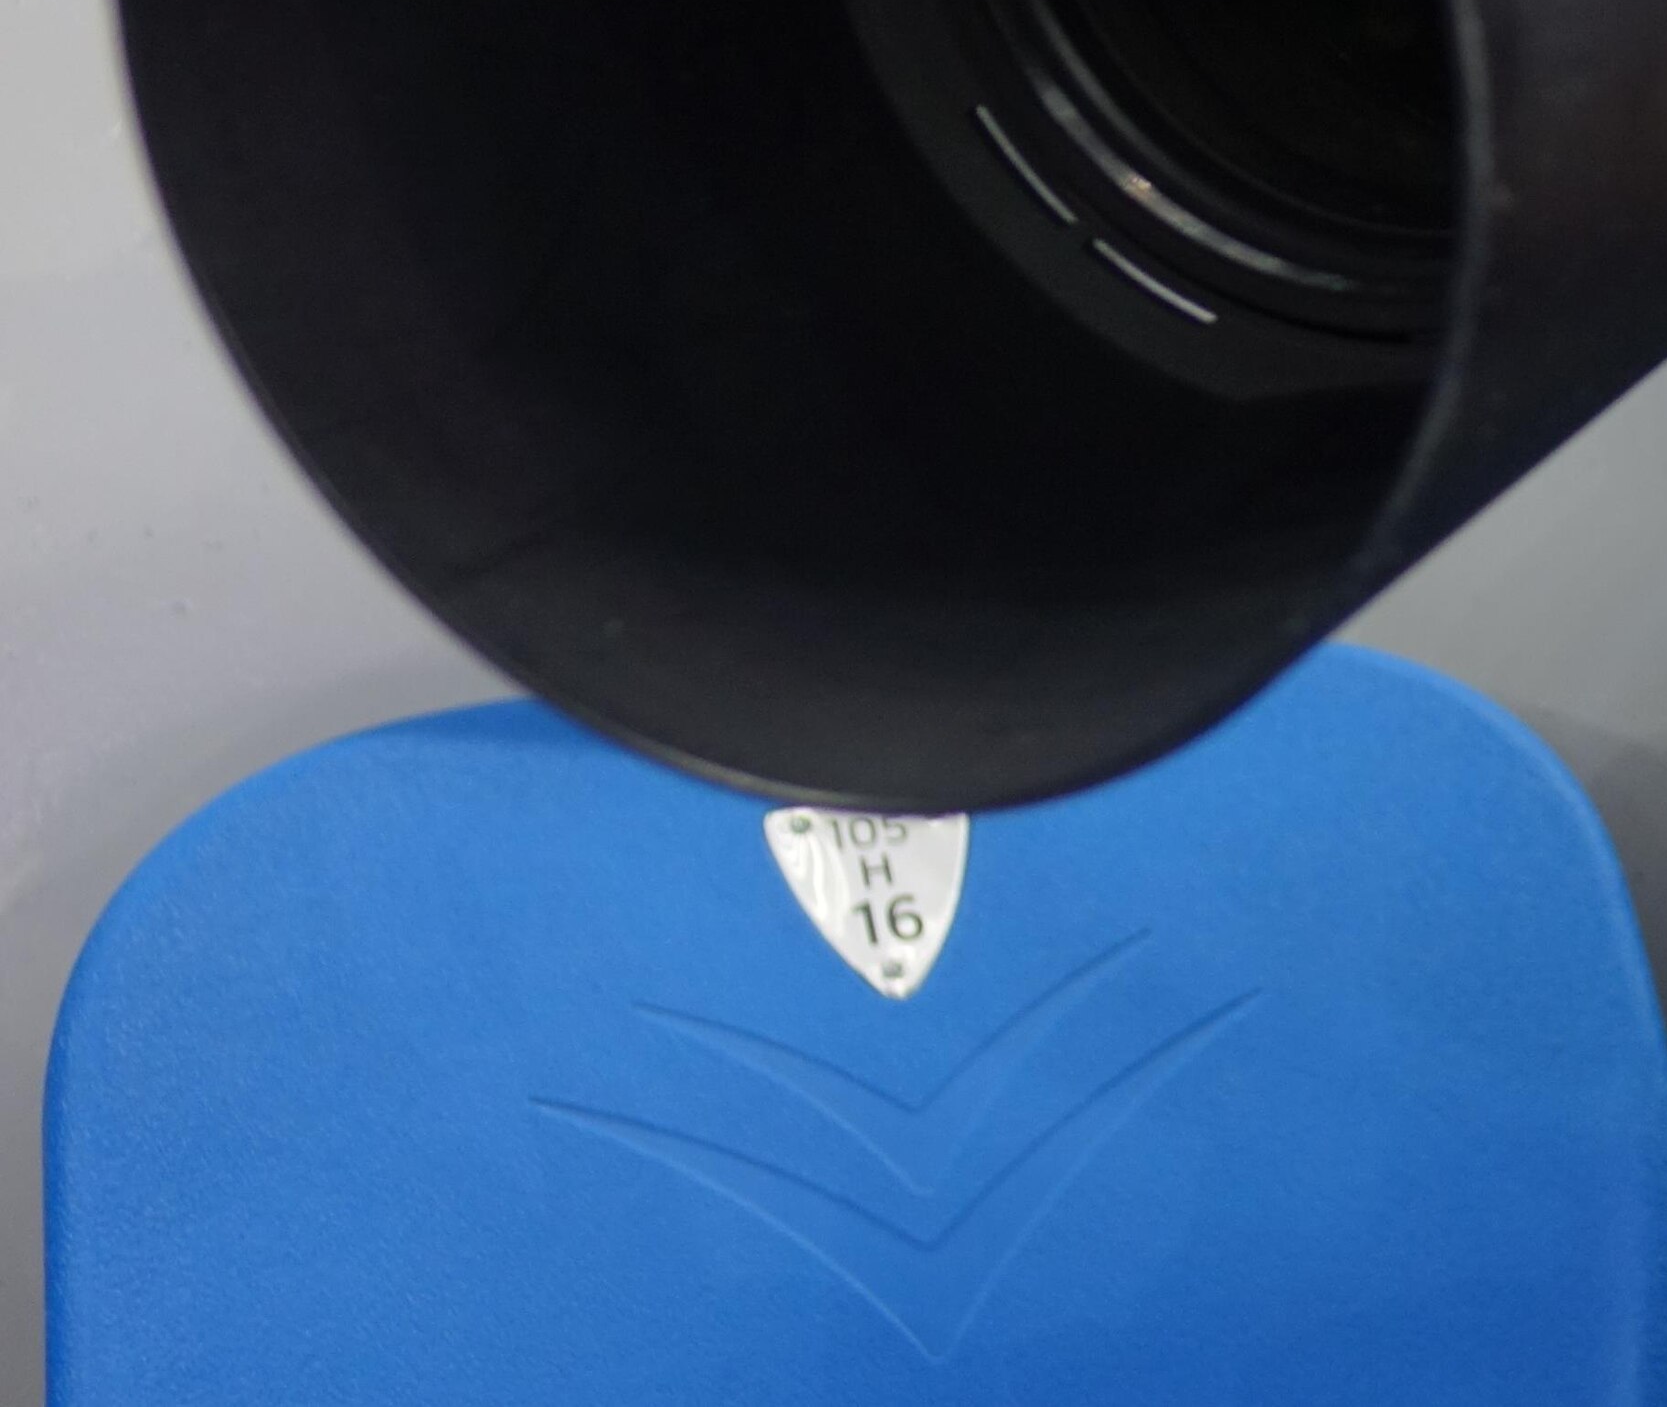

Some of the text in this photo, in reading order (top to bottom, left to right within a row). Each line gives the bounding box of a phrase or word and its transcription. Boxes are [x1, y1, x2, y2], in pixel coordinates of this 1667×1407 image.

[826, 815, 908, 852] 105
[860, 853, 894, 887] H
[852, 893, 924, 946] 16
